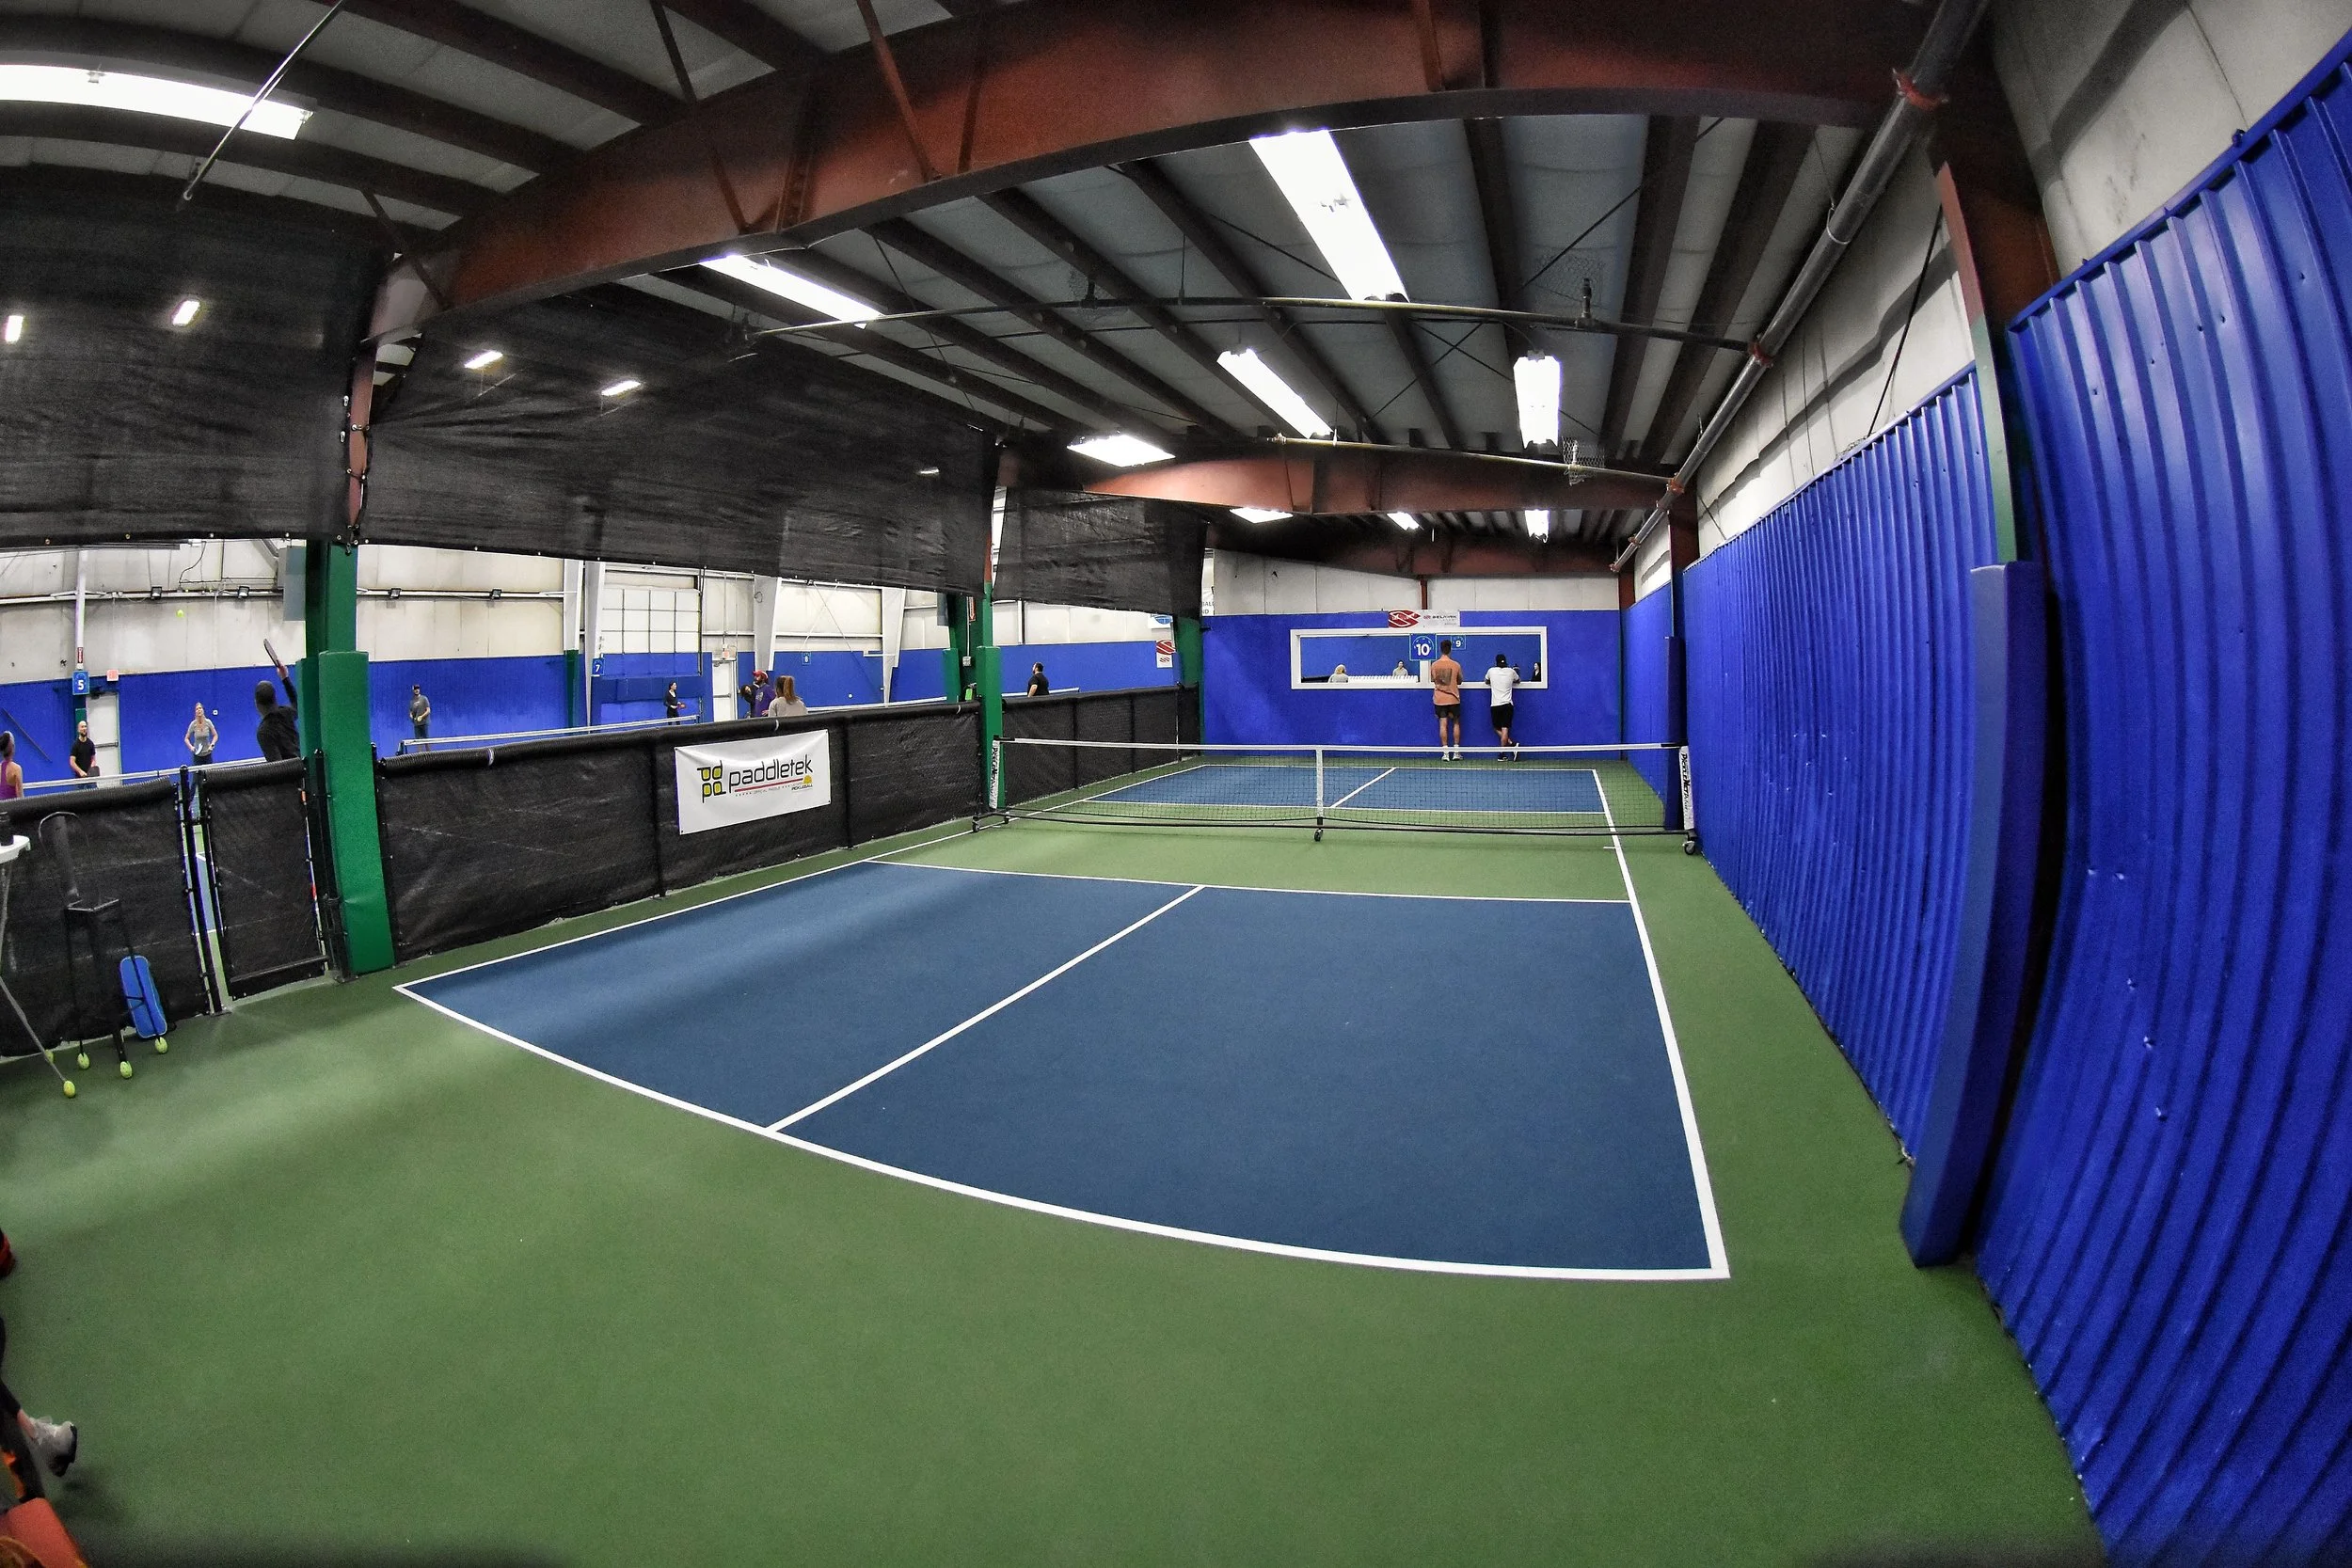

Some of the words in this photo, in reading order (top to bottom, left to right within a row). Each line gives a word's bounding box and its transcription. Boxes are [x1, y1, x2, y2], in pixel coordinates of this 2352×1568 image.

[1416, 643, 1430, 656] 10
[596, 664, 601, 673] 7
[78, 679, 85, 690] 5
[729, 754, 813, 793] paddletek
